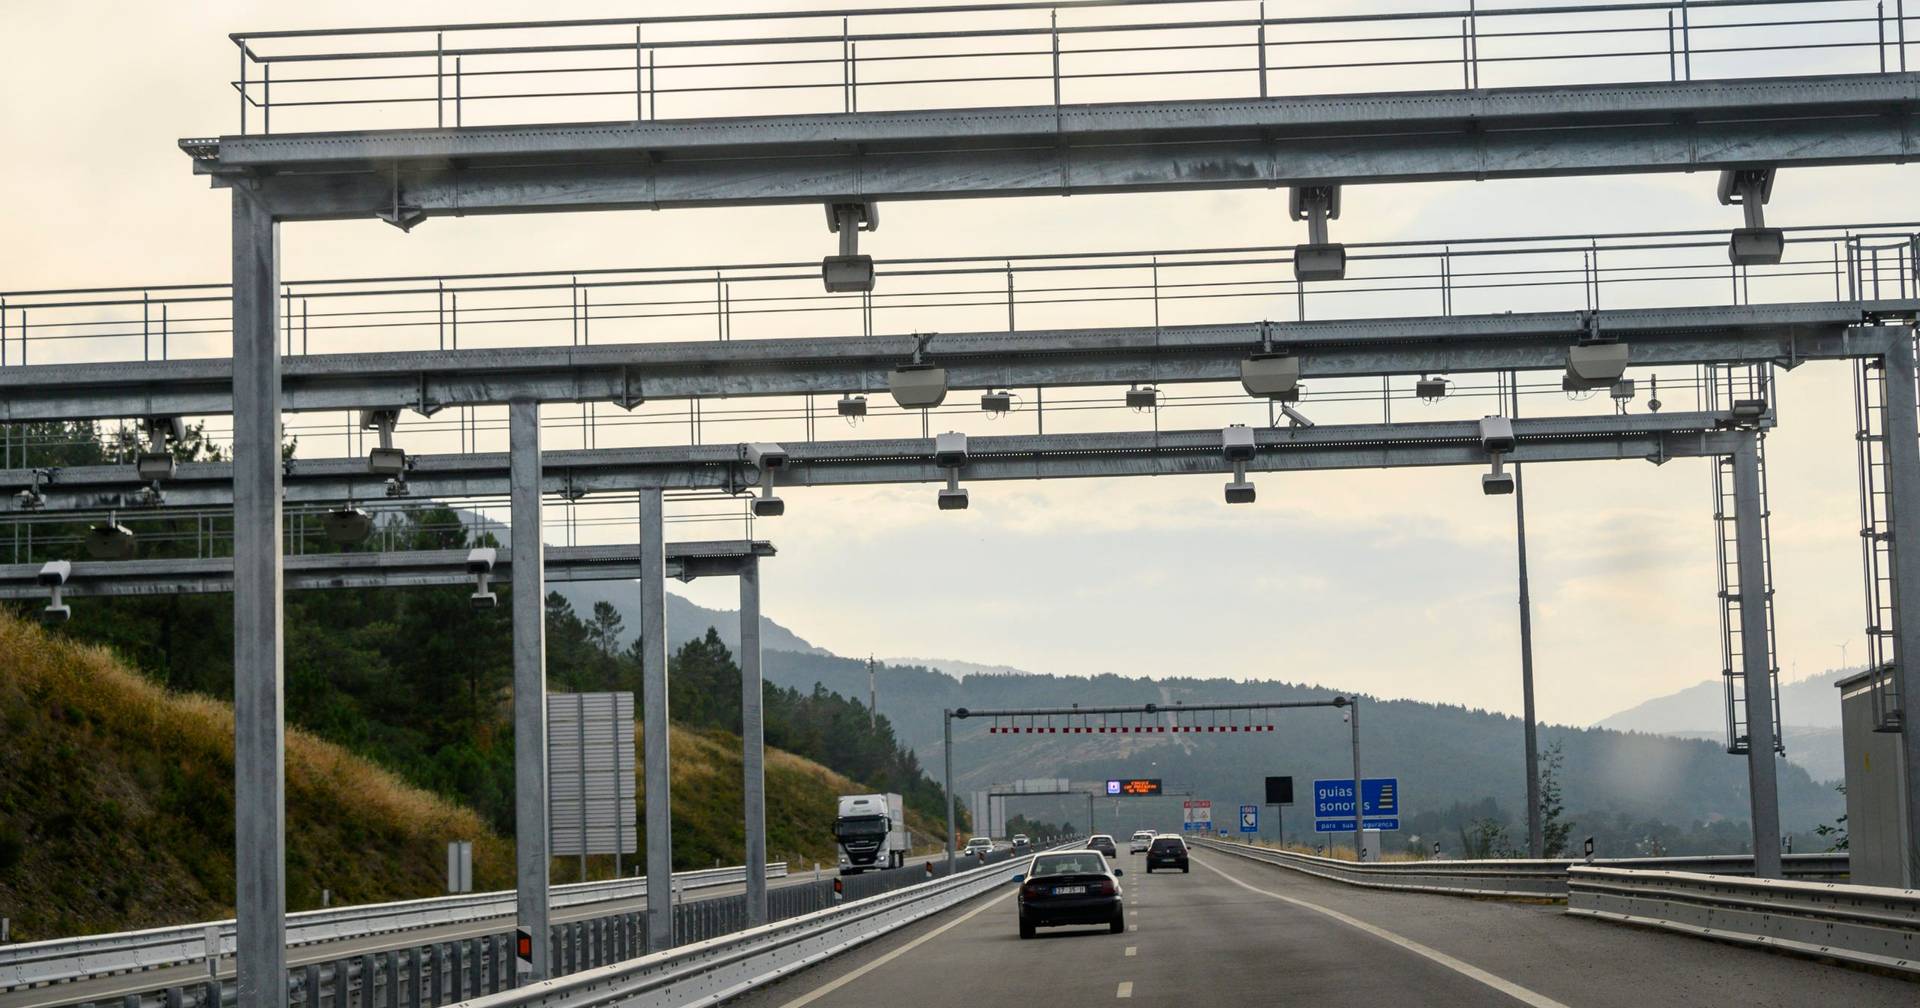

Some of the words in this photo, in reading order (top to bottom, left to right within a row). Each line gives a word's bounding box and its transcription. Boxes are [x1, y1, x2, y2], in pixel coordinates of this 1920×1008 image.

[1319, 786, 1353, 800] guias
[1320, 801, 1370, 812] sonors
[1363, 821, 1393, 829] egurança
